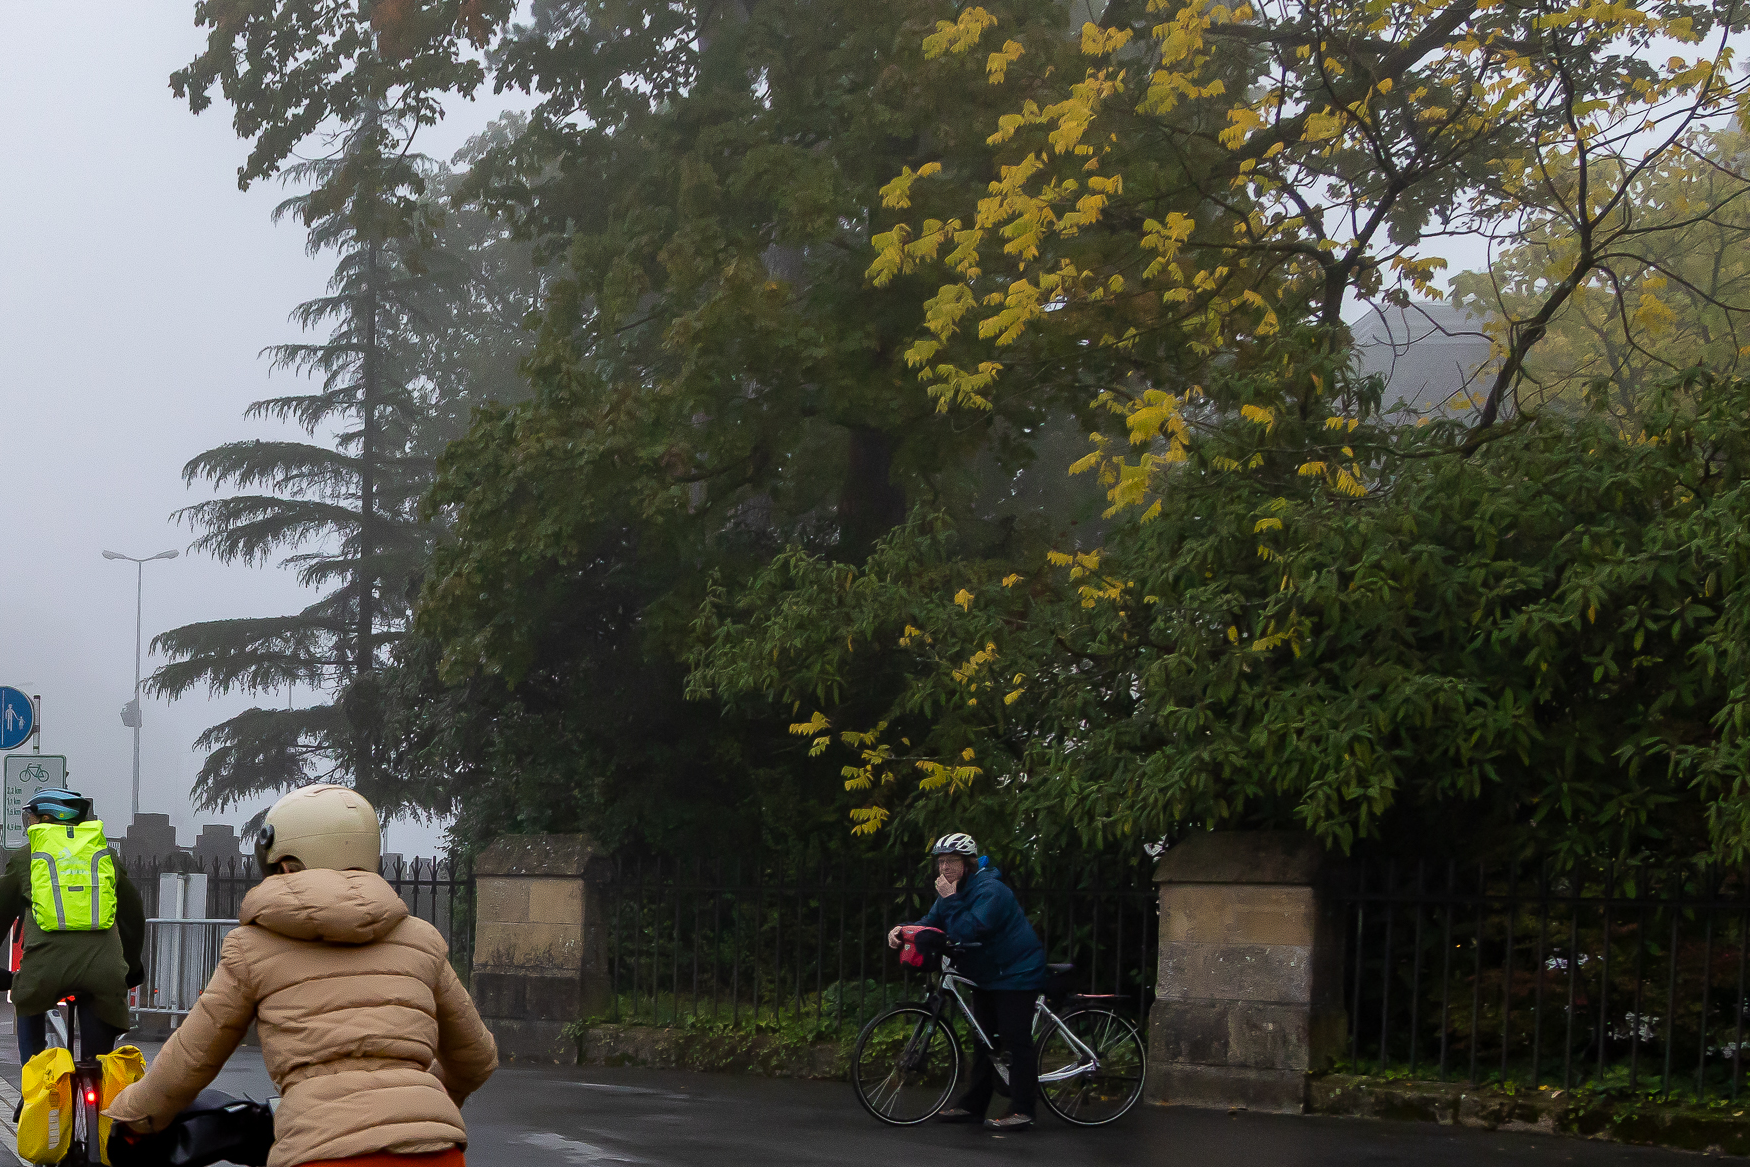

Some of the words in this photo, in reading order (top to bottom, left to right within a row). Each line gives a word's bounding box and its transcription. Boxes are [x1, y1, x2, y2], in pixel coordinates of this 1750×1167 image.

[15, 786, 22, 794] km
[14, 808, 21, 816] km
[14, 822, 22, 830] km
